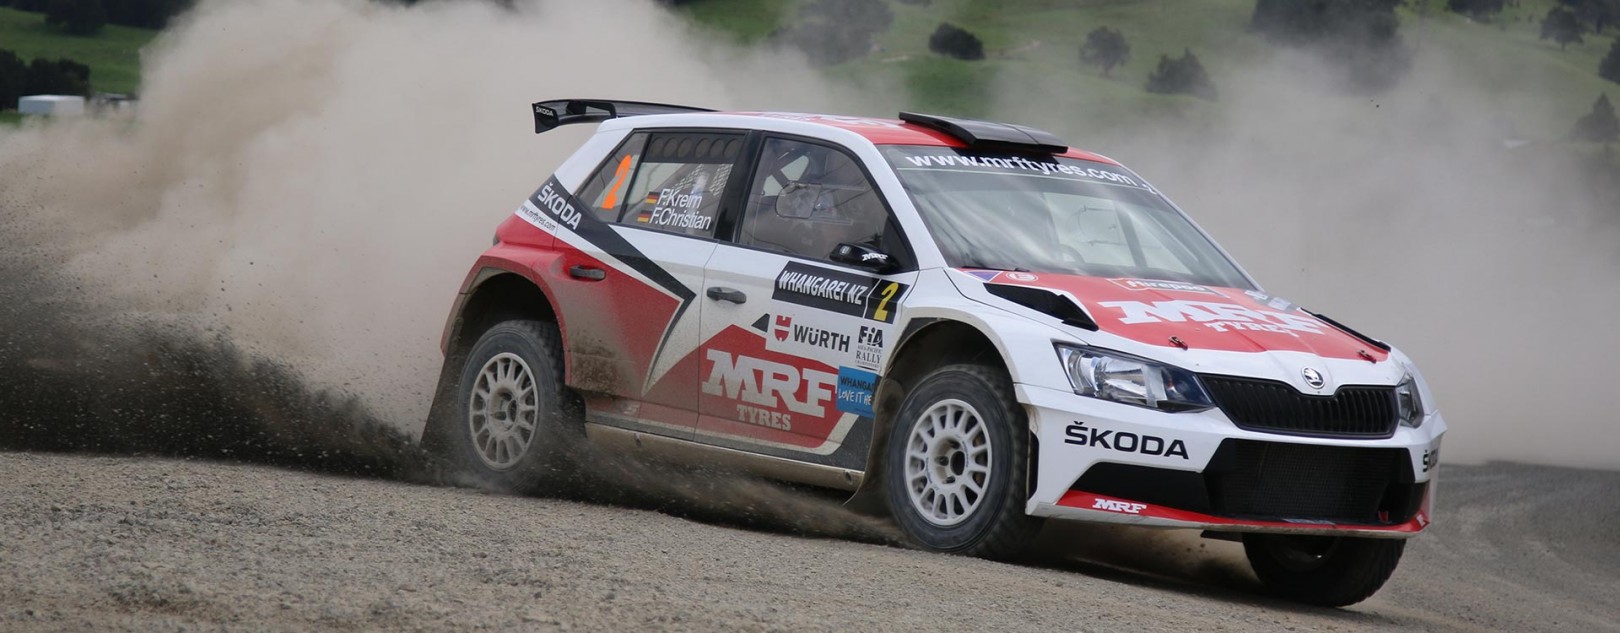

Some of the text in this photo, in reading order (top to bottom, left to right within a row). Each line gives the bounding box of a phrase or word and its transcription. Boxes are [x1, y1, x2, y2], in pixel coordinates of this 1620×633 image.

[602, 154, 632, 209] 2
[906, 153, 1137, 187] www.mrftyres.com
[537, 183, 582, 230] ŠKODA
[657, 188, 703, 209] F.Kreim
[649, 206, 712, 230] F.Christian
[778, 270, 868, 305] WHANGAREI NZ
[873, 282, 899, 322] 2
[1097, 300, 1327, 336] MRF
[793, 324, 851, 353] WÜRTH
[856, 350, 882, 364] RALLY
[701, 348, 839, 418] MRF
[838, 388, 855, 402] LOVE
[855, 391, 865, 404] IT
[737, 404, 791, 432] TYRES
[1064, 420, 1189, 460] ŠKODA
[1092, 498, 1147, 514] MRF
